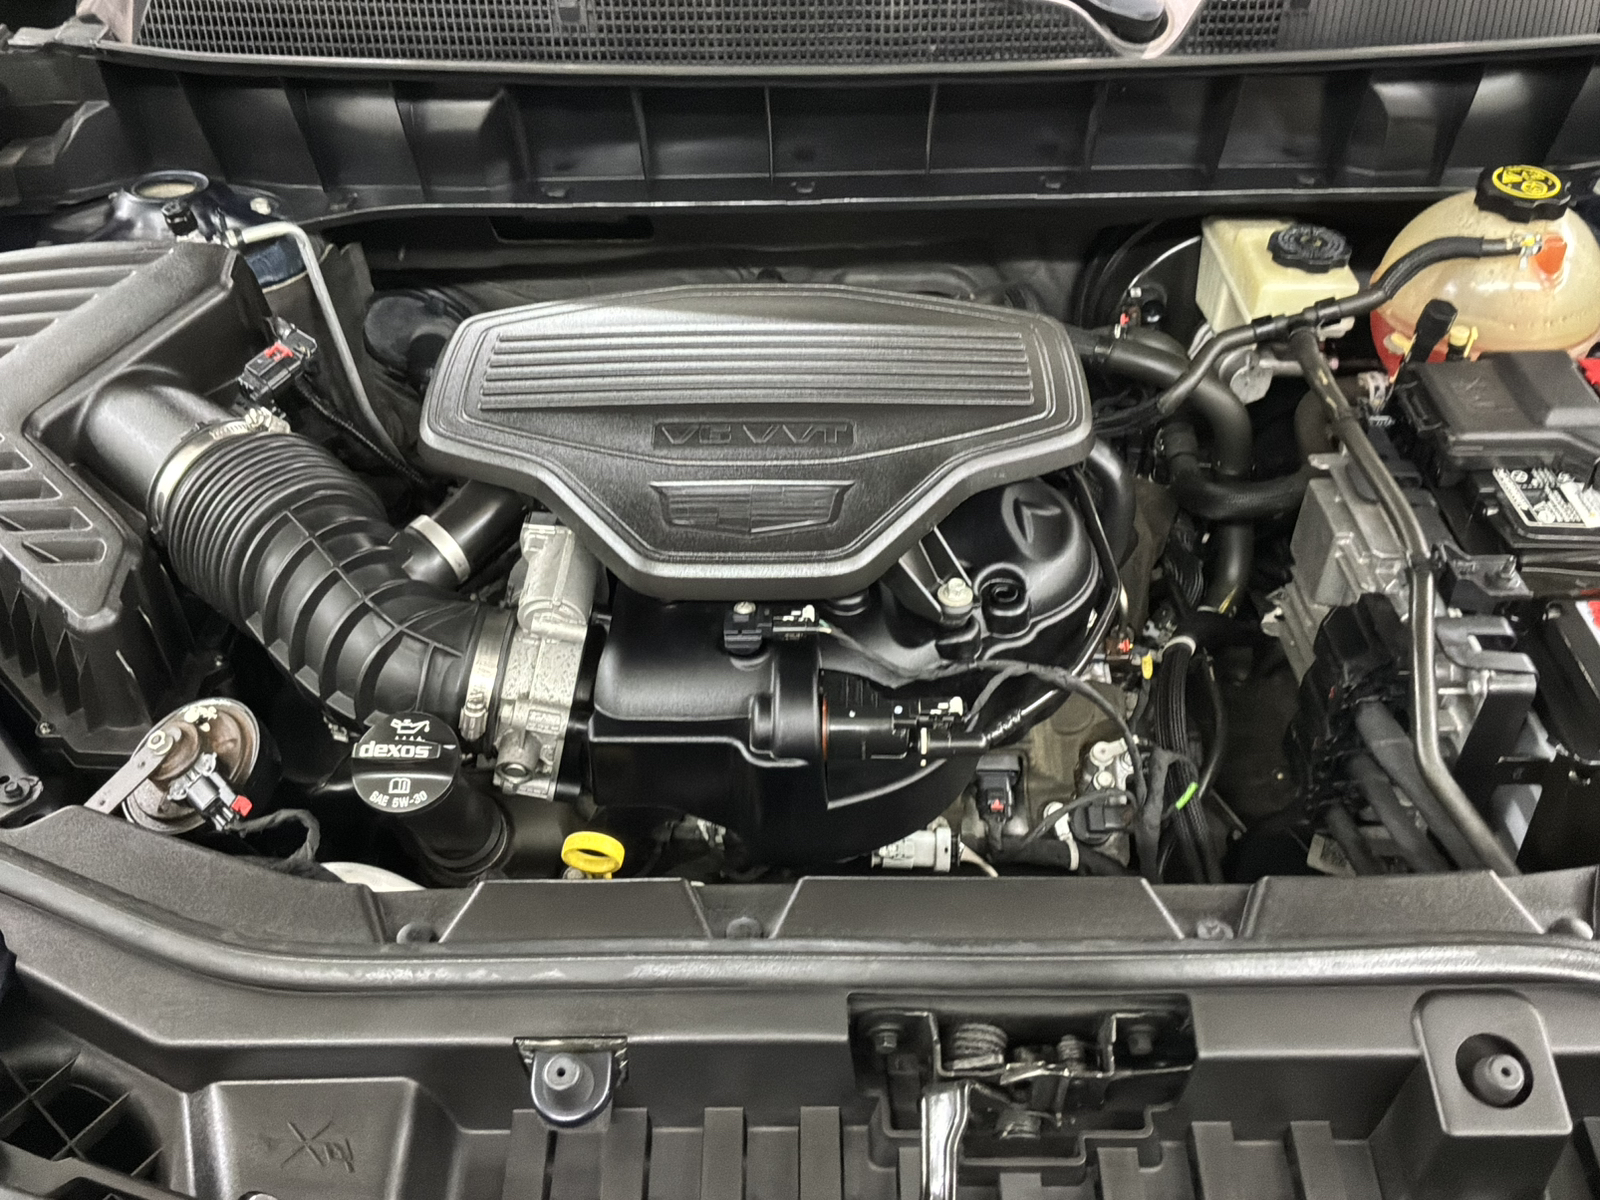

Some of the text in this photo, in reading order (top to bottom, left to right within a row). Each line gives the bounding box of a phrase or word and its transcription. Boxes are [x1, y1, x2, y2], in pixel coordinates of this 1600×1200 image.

[661, 423, 848, 445] V6 VVT
[359, 740, 430, 759] dexos
[369, 790, 428, 808] SAE 5W-30
